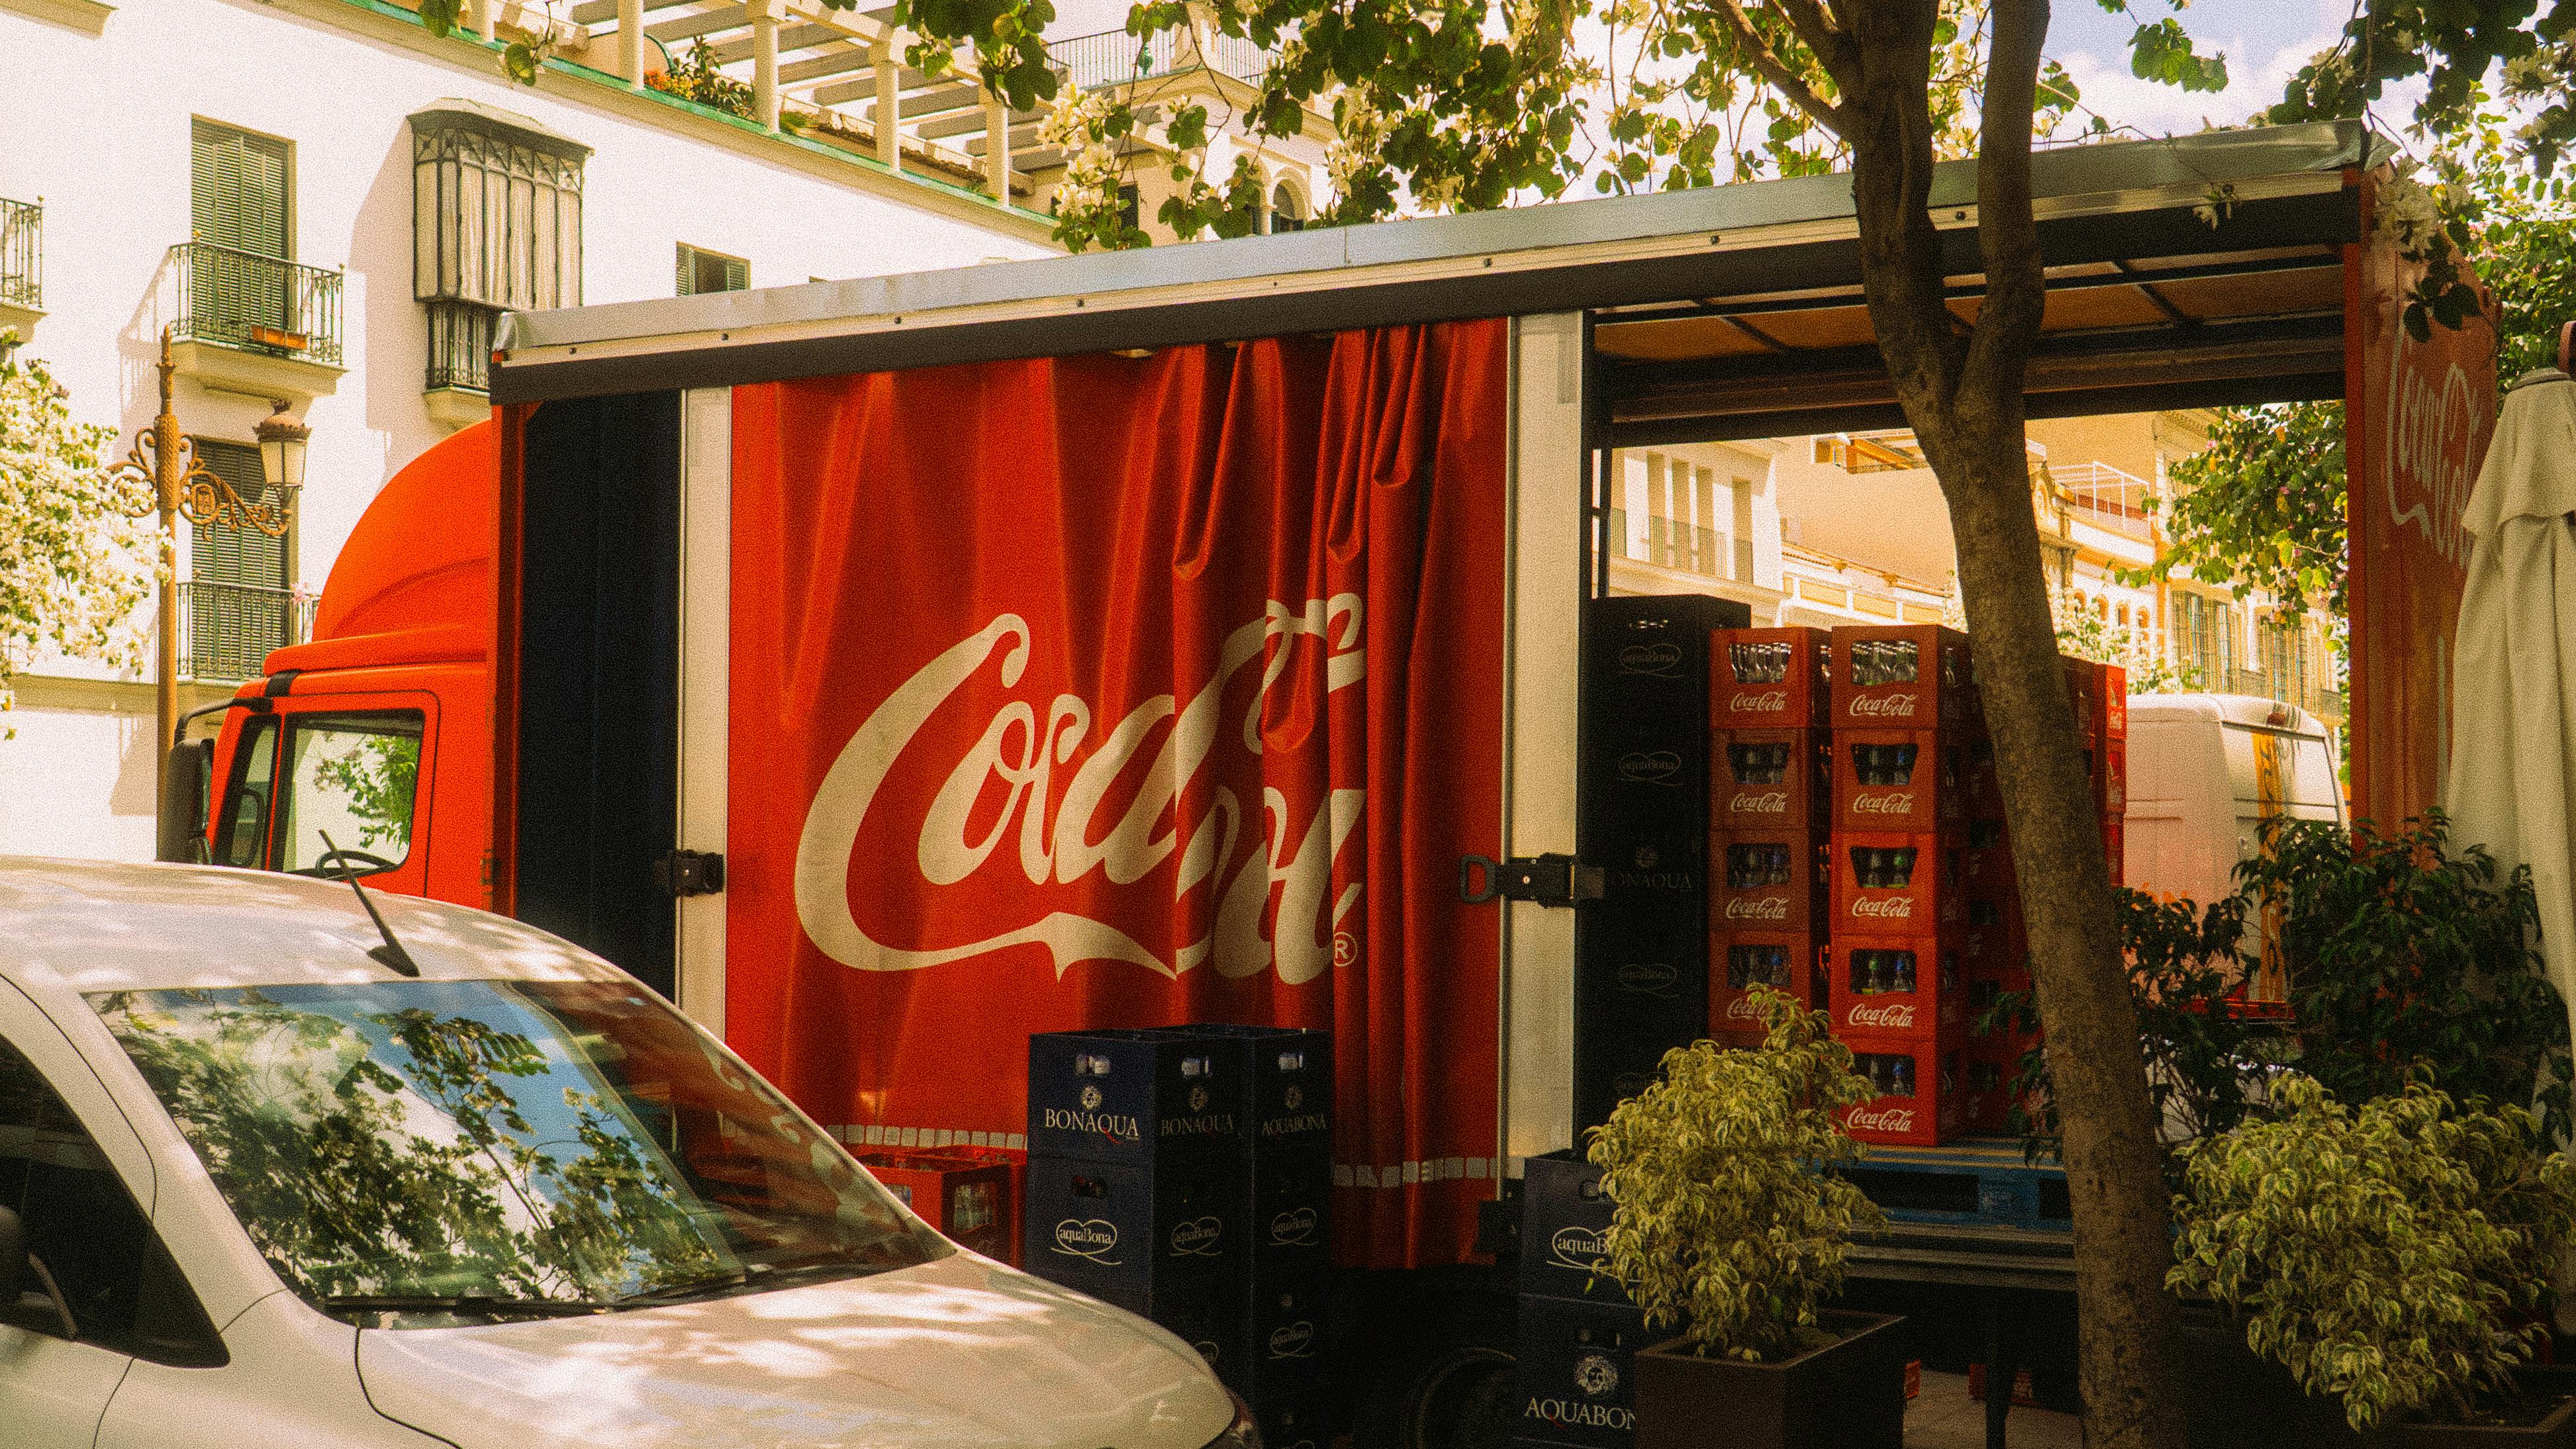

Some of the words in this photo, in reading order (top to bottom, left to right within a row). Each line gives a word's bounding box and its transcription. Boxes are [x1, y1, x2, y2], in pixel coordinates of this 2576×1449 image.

[1730, 690, 1788, 713] Coca-Cola
[1848, 693, 1919, 717] Coca-Cola
[1730, 792, 1789, 814] Coca-Cola
[1852, 792, 1914, 814] Coca-Cola
[1725, 896, 1791, 920] Coca-Cola
[1851, 896, 1915, 918] Coca-Cola
[1847, 1002, 1917, 1028] Coca-Cola
[1043, 1107, 1140, 1145] BONAQUA
[1161, 1112, 1235, 1143] BONAQUA
[1846, 1106, 1917, 1133] Coca-Cola
[1059, 1227, 1112, 1244] aquaBona
[1173, 1225, 1219, 1245] aquaBona
[1556, 1235, 1608, 1256] aquaB
[1523, 1396, 1637, 1430] AQUABON
